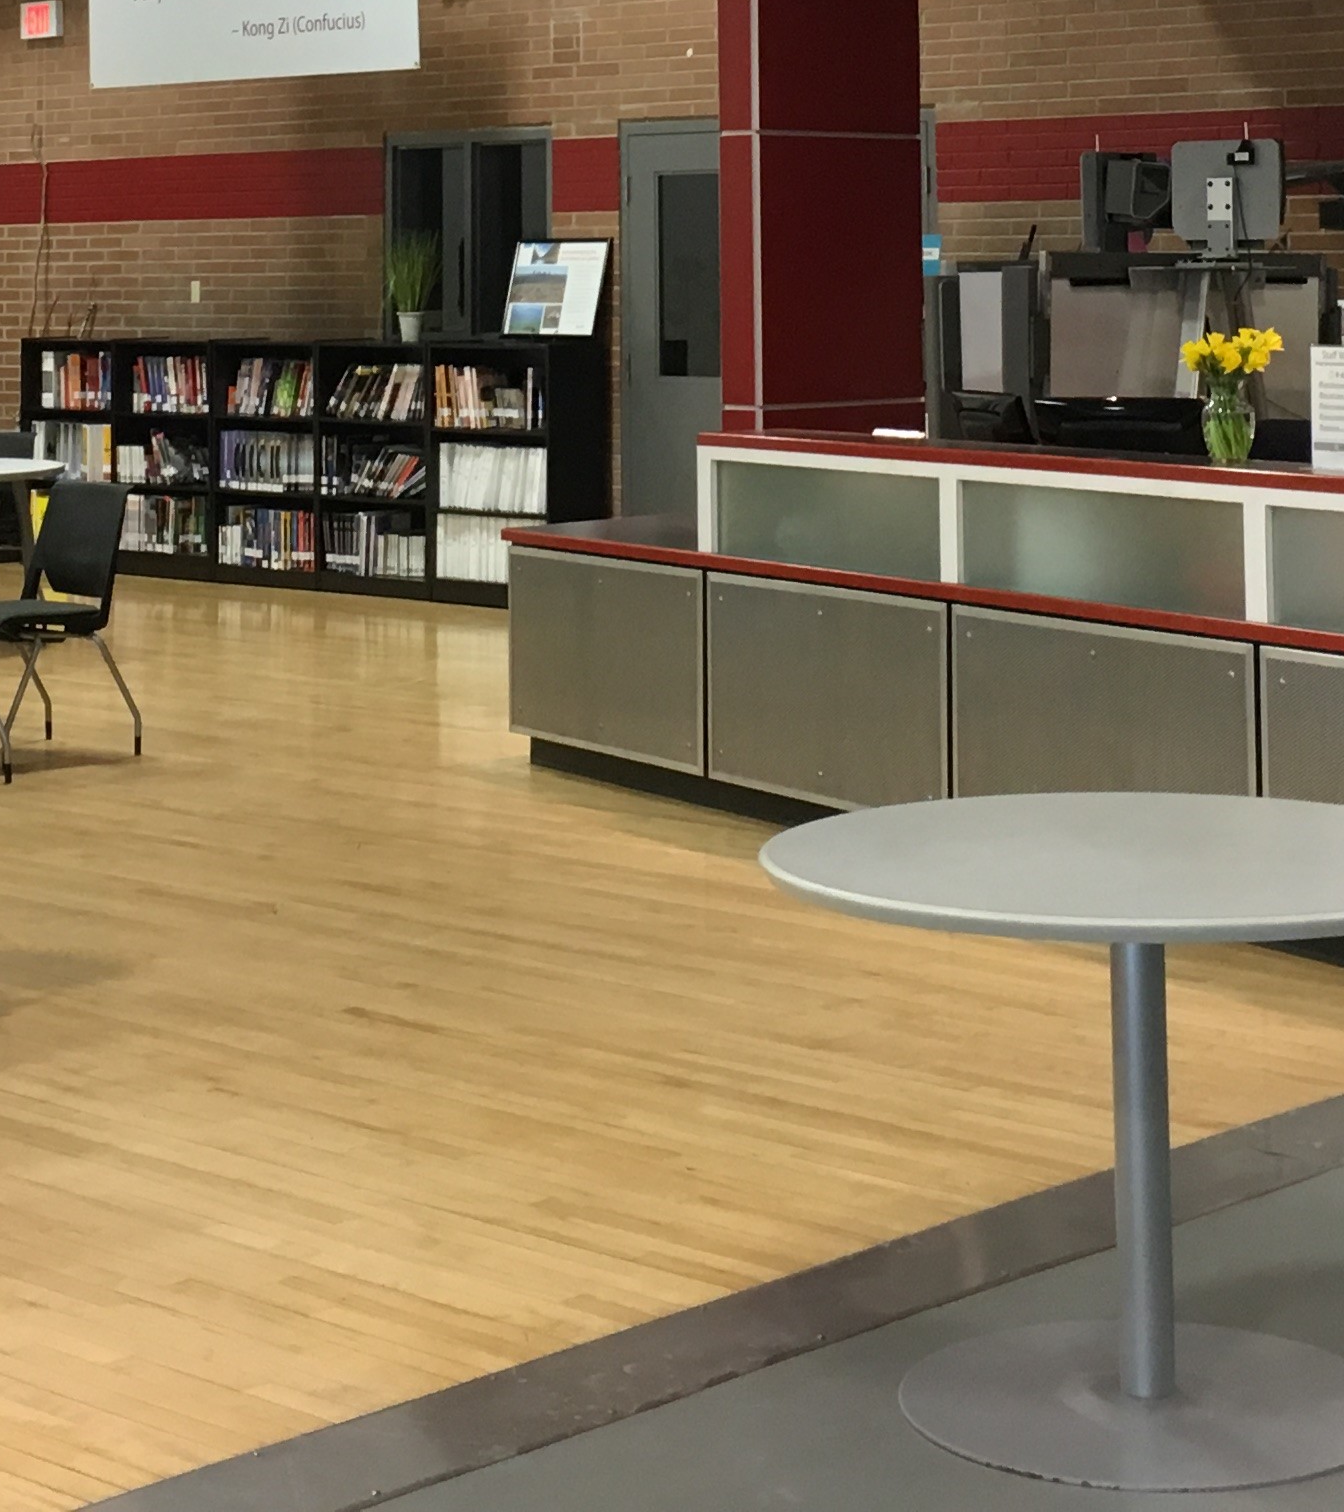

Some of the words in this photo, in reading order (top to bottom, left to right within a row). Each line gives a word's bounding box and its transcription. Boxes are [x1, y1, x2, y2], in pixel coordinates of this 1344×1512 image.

[242, 20, 275, 40] Kong
[277, 17, 290, 35] Zi
[292, 11, 366, 36] (Confucius)
